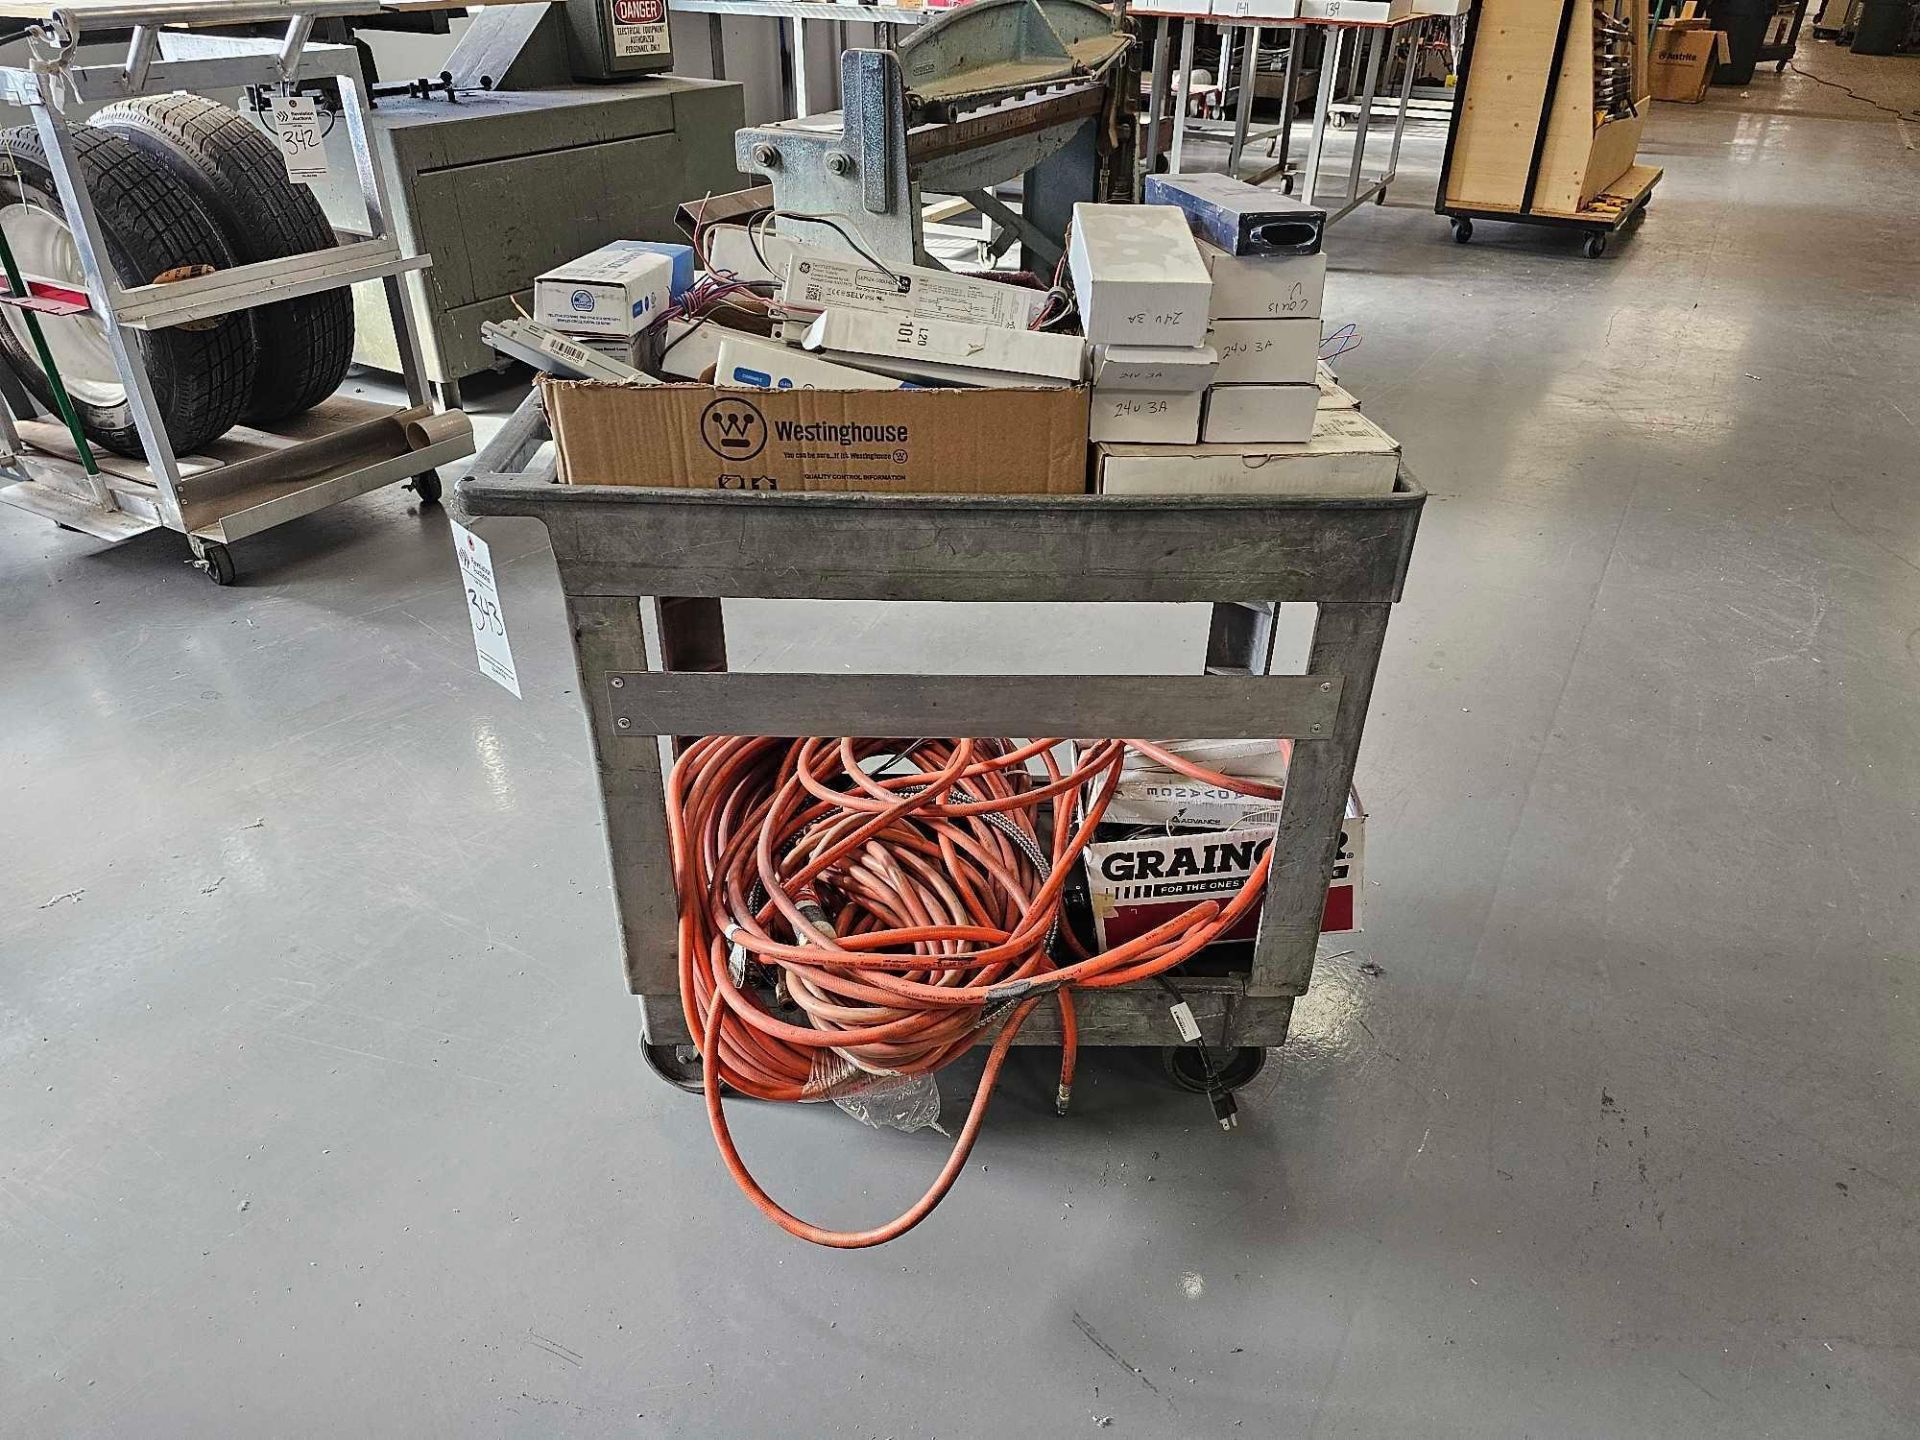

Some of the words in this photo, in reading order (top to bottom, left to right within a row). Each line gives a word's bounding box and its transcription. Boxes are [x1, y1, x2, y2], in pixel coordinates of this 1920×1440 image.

[619, 0, 658, 19] DANGER
[1325, 2, 1340, 17] 139
[283, 129, 320, 155] 342
[1127, 313, 1146, 324] 3A
[897, 321, 914, 343] 101
[917, 327, 929, 347] L20
[1254, 339, 1273, 352] 3A
[1146, 400, 1168, 414] 3A
[774, 420, 908, 446] Westinghouse
[850, 452, 892, 460] Westinghouse
[467, 588, 504, 636] 343
[1180, 818, 1221, 826] ADVANCE
[1160, 885, 1183, 894] FOR
[1186, 882, 1207, 892] THE
[1209, 880, 1239, 889] ONES
